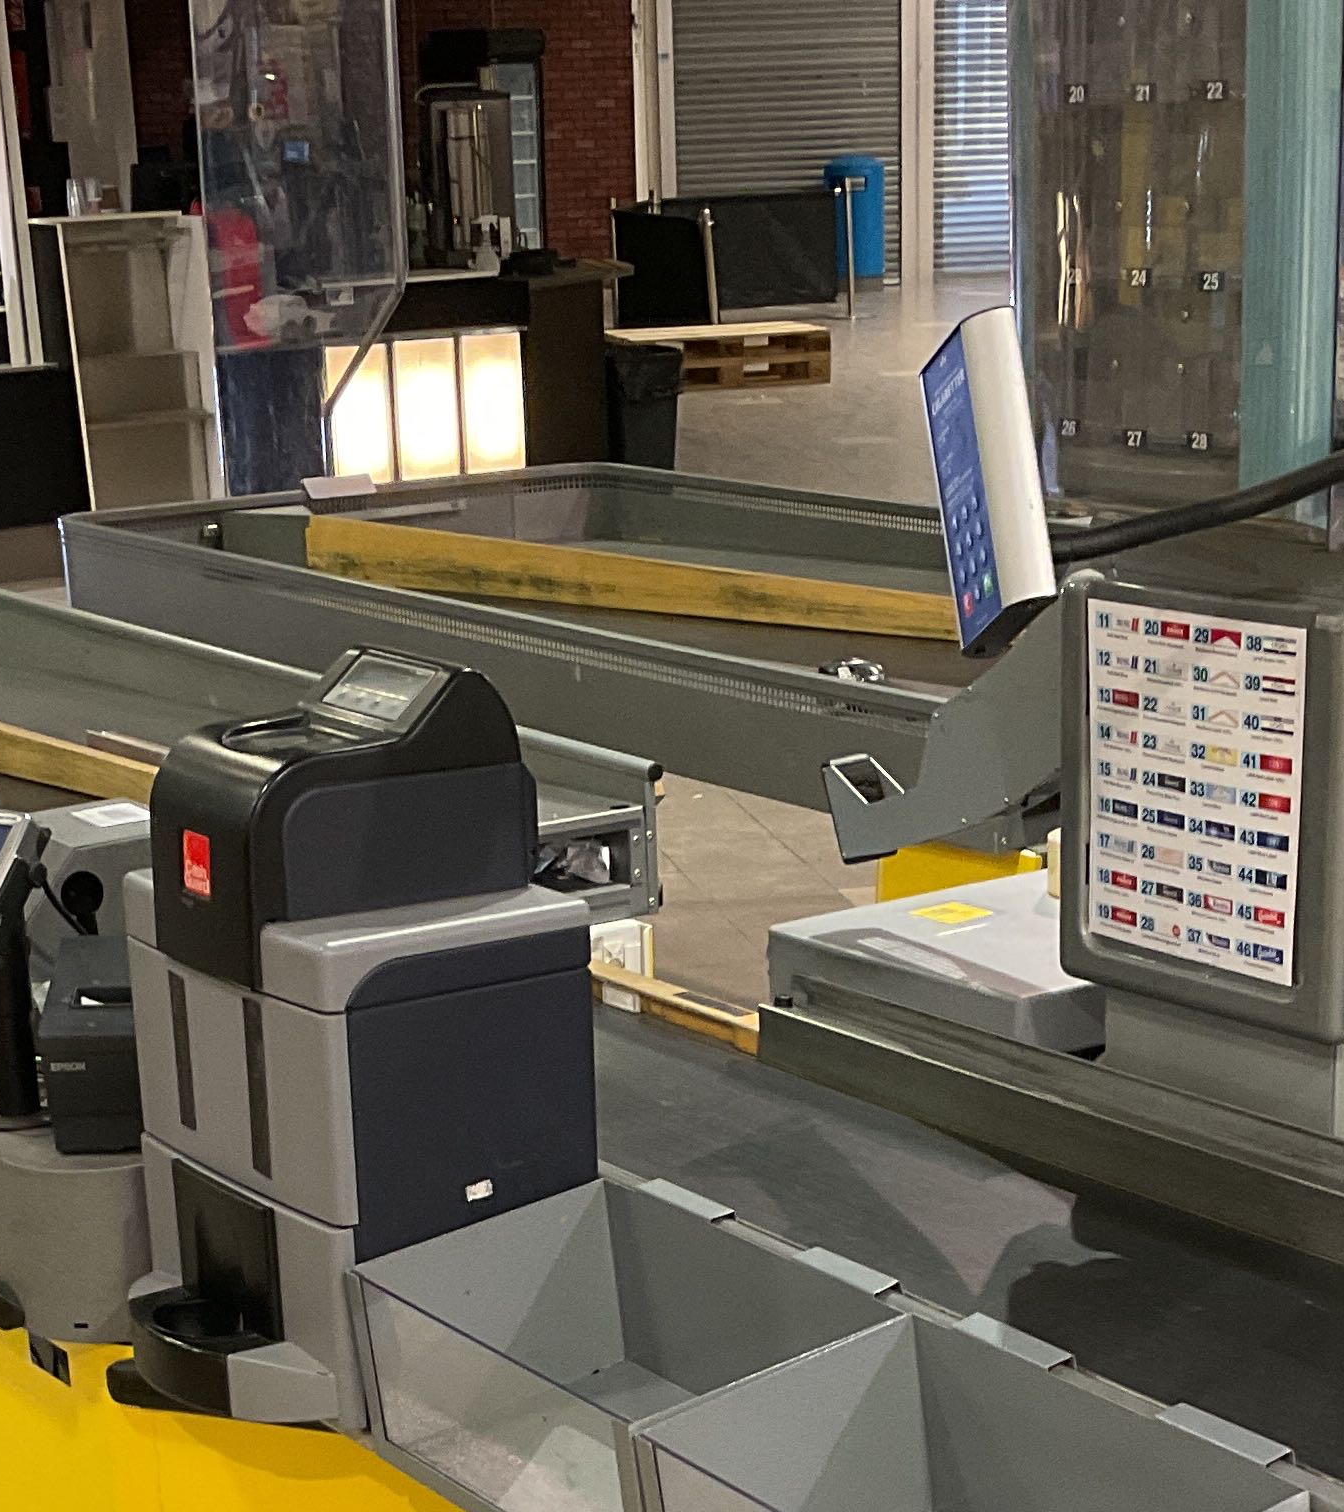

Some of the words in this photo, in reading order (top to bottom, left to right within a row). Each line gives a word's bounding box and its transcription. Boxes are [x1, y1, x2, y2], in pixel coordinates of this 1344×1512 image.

[1069, 86, 1085, 102] 20
[1135, 85, 1151, 101] 21
[1207, 82, 1224, 100] 22
[1130, 269, 1147, 287] 24
[1203, 273, 1220, 291] 25
[1061, 420, 1077, 437] 26
[1126, 430, 1143, 448] 27
[1191, 432, 1208, 450] 28
[1098, 613, 1110, 629] 11
[1144, 619, 1159, 636] 20
[1194, 627, 1209, 643] 29
[1246, 635, 1262, 652] 38
[1098, 651, 1111, 667] 12
[1144, 658, 1157, 674] 21
[1193, 666, 1208, 682] 30
[1245, 675, 1260, 691] 39
[1098, 688, 1111, 704] 13
[1143, 696, 1158, 713] 22
[1192, 705, 1206, 721] 31
[1243, 714, 1260, 730] 40
[1099, 725, 1111, 740] 14
[1142, 734, 1157, 750] 23
[1190, 744, 1206, 760] 32
[1242, 752, 1257, 769] 41
[1099, 761, 1111, 777] 15
[1142, 771, 1156, 787] 24
[1190, 780, 1205, 797] 33
[1241, 792, 1257, 808] 42
[1141, 807, 1156, 824] 25
[1188, 817, 1204, 835] 34
[1098, 833, 1111, 848] 17
[1239, 830, 1255, 846] 43
[1188, 855, 1203, 872] 35
[1238, 867, 1254, 883] 44
[1141, 879, 1155, 896] 27
[1098, 904, 1110, 919] 19
[1237, 904, 1253, 920] 45
[1140, 916, 1155, 932] 28
[1187, 928, 1202, 944] 37
[1236, 941, 1253, 957] 46
